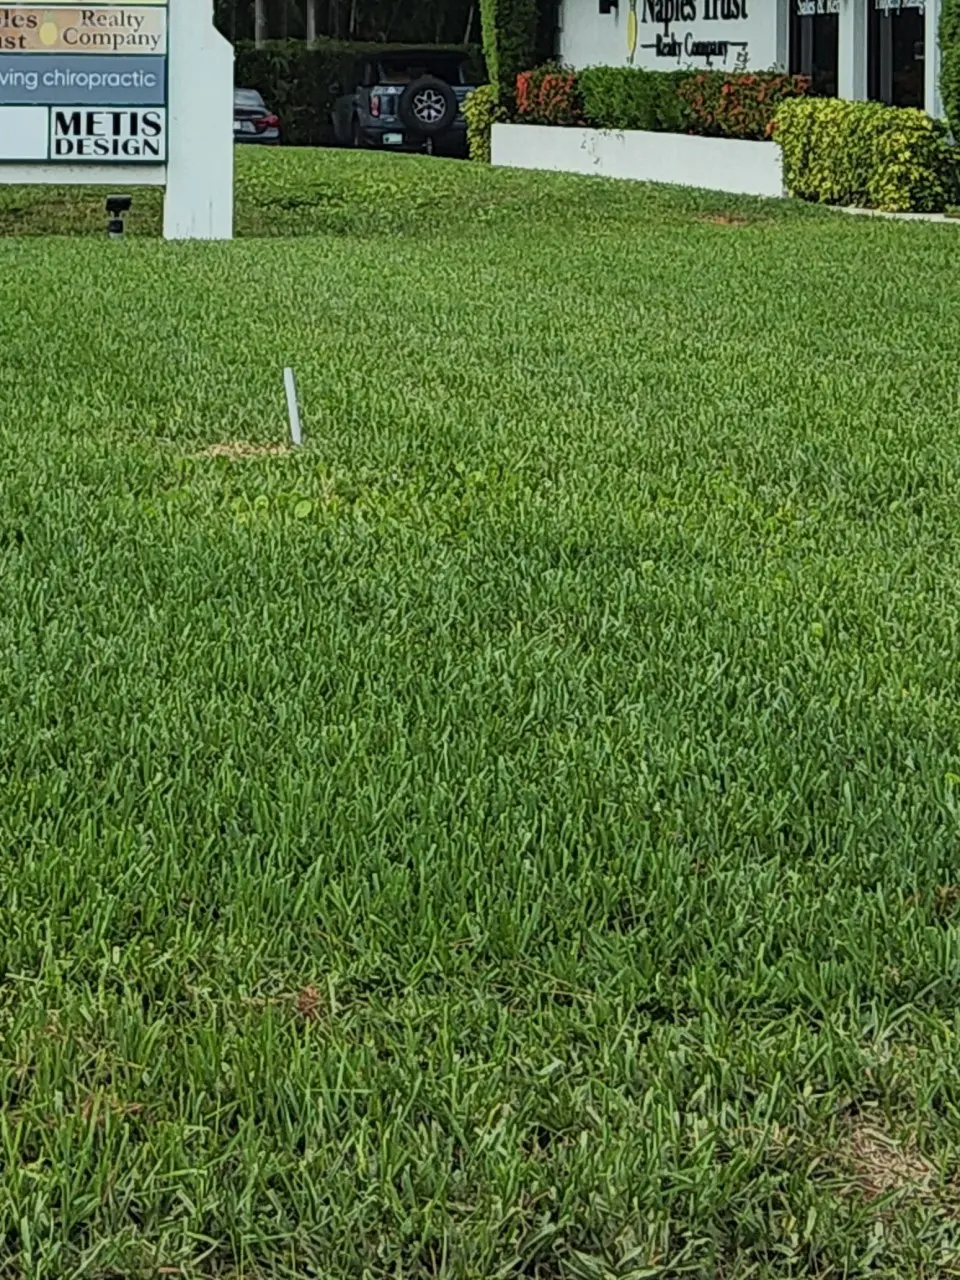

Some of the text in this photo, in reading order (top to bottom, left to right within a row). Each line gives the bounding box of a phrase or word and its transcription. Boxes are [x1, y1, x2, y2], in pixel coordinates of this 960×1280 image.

[80, 10, 145, 32] Realty
[62, 28, 162, 51] Company
[43, 67, 157, 91] chiropractic
[54, 110, 162, 136] METIS
[54, 138, 161, 157] DESIGN
